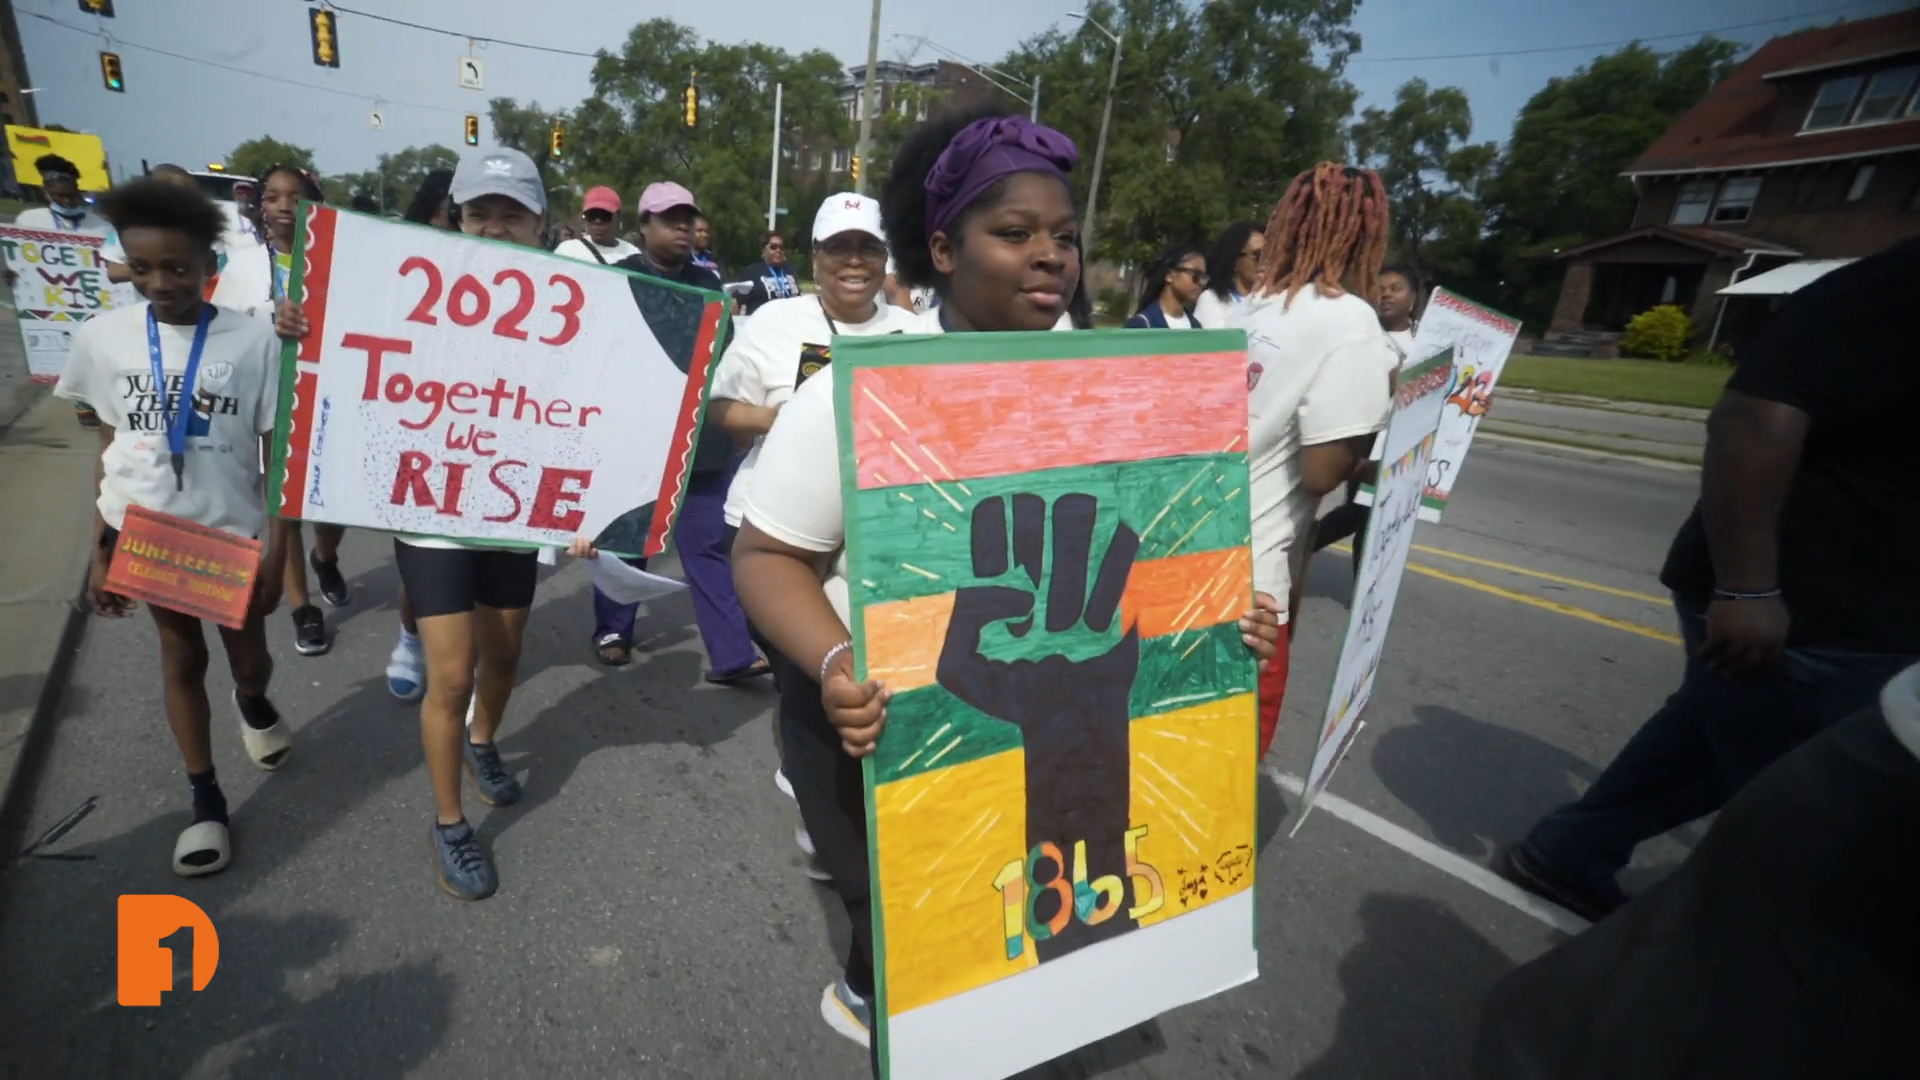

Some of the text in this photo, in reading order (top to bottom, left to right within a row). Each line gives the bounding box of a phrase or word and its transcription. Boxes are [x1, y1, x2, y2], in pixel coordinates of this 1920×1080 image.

[0, 240, 108, 268] TOGETH
[36, 267, 101, 291] WE
[44, 286, 115, 311] RISE
[399, 256, 585, 346] 2023
[136, 393, 239, 415] TEETH
[340, 333, 602, 430] Together
[390, 451, 593, 532] RISE
[992, 824, 1165, 960] 1865
